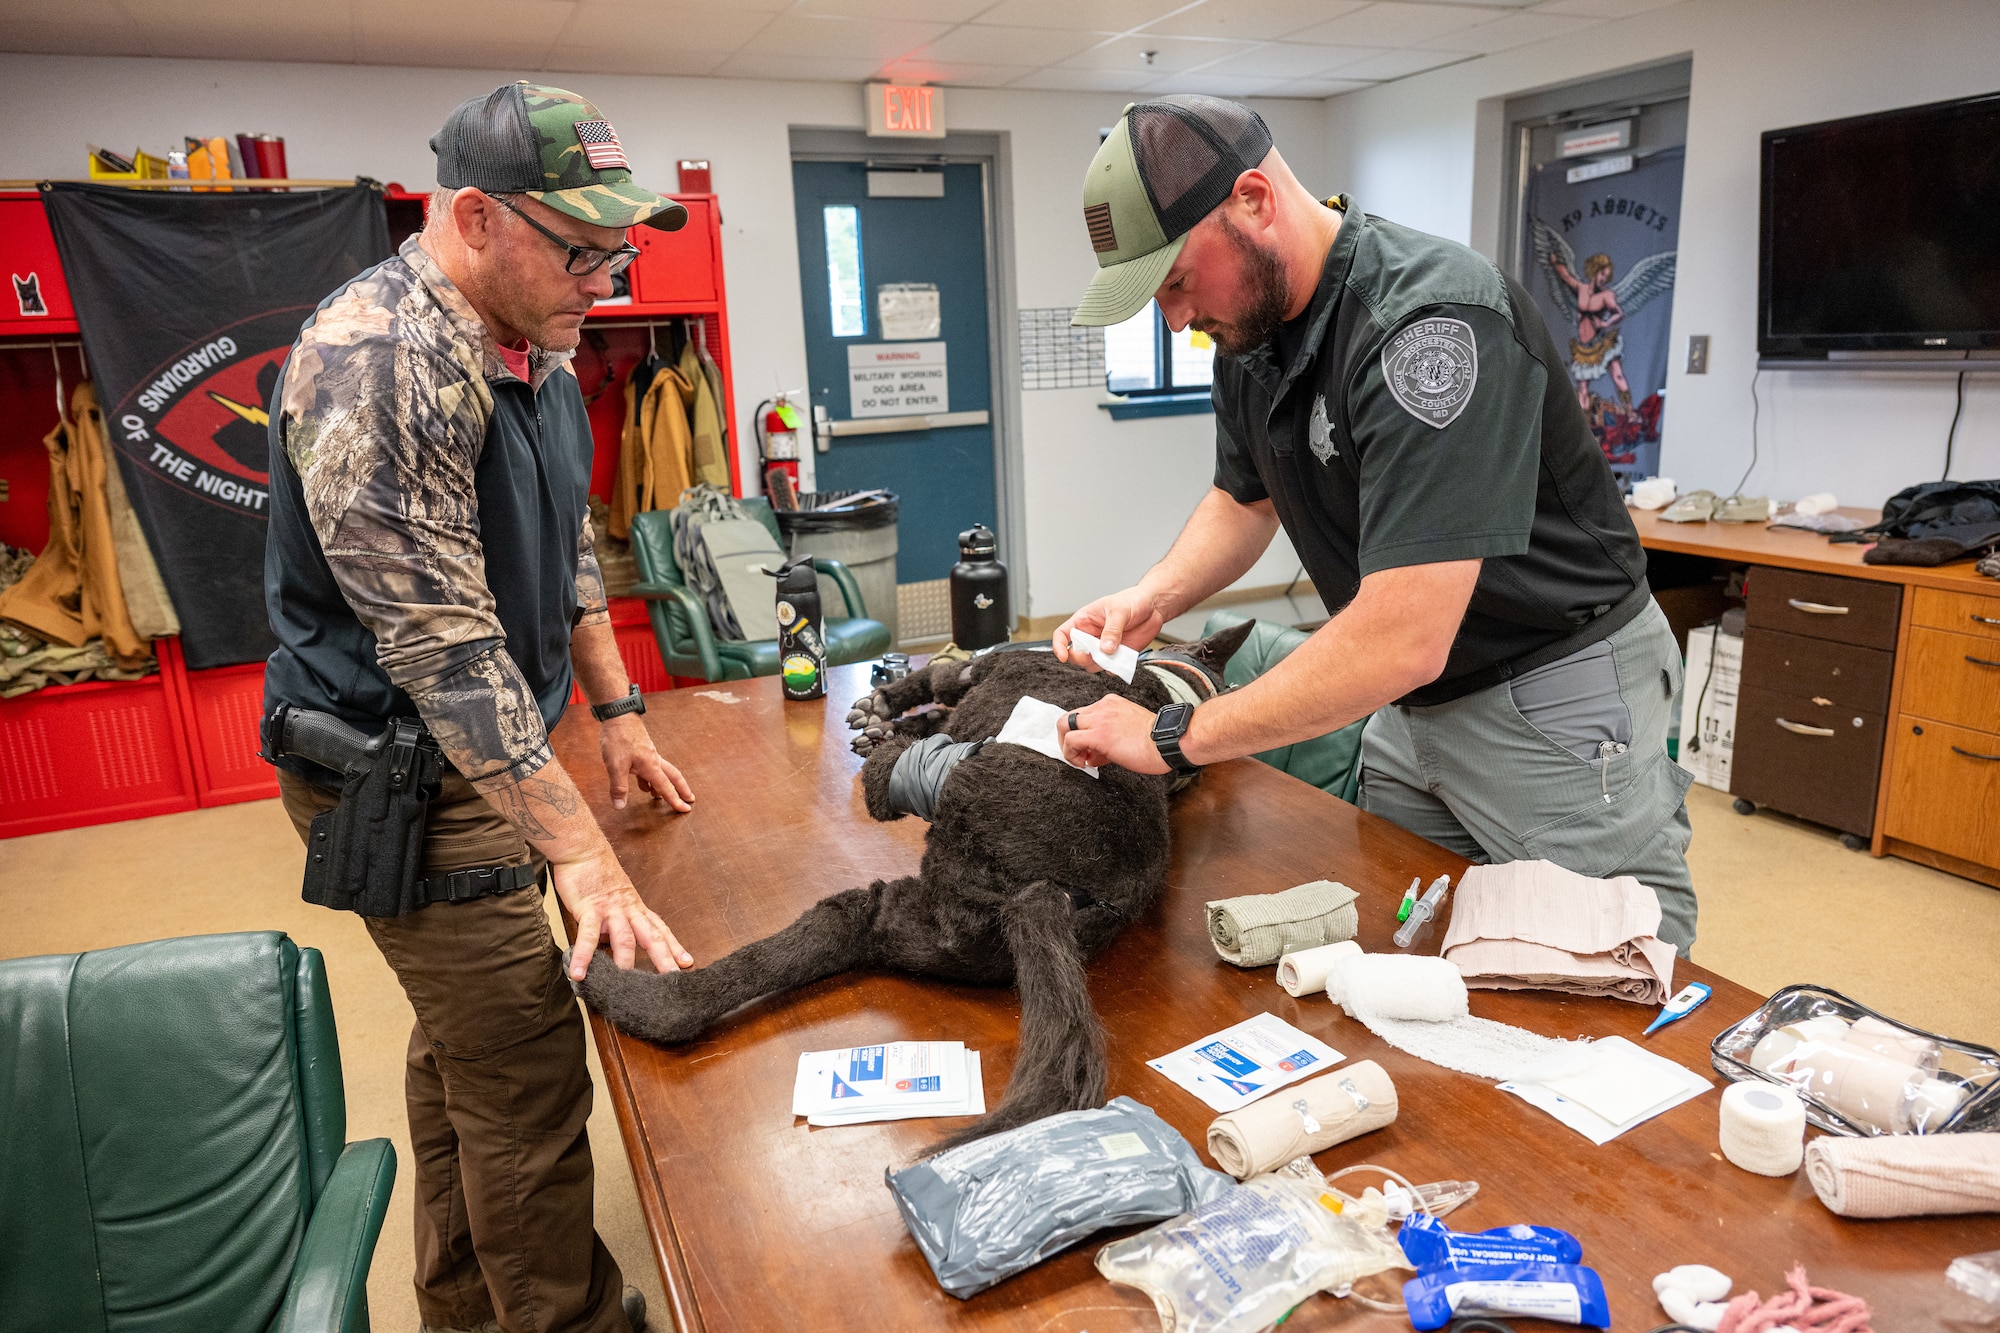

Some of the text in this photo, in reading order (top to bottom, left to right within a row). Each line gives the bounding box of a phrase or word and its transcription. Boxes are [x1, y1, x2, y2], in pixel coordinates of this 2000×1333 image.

[883, 86, 934, 132] EXIT
[1562, 209, 1582, 232] K9
[1394, 323, 1460, 348] SHERIFF
[1403, 338, 1456, 359] WORCESTER
[876, 352, 921, 361] WARNING
[853, 370, 944, 382] MILITARY WORKING
[873, 383, 926, 394] DOG AREA
[862, 396, 939, 408] DO NOT ENTER
[1421, 395, 1457, 407] COUNTY
[1432, 409, 1449, 418] MD
[121, 336, 269, 510] GUARDIANS OF THE NIGHT
[1704, 733, 1718, 744] UP
[1469, 1248, 1512, 1260] MEDICAL
[1513, 1251, 1534, 1261] FOR
[1535, 1253, 1556, 1262] NOT
[1202, 1252, 1242, 1294] LACTATED
